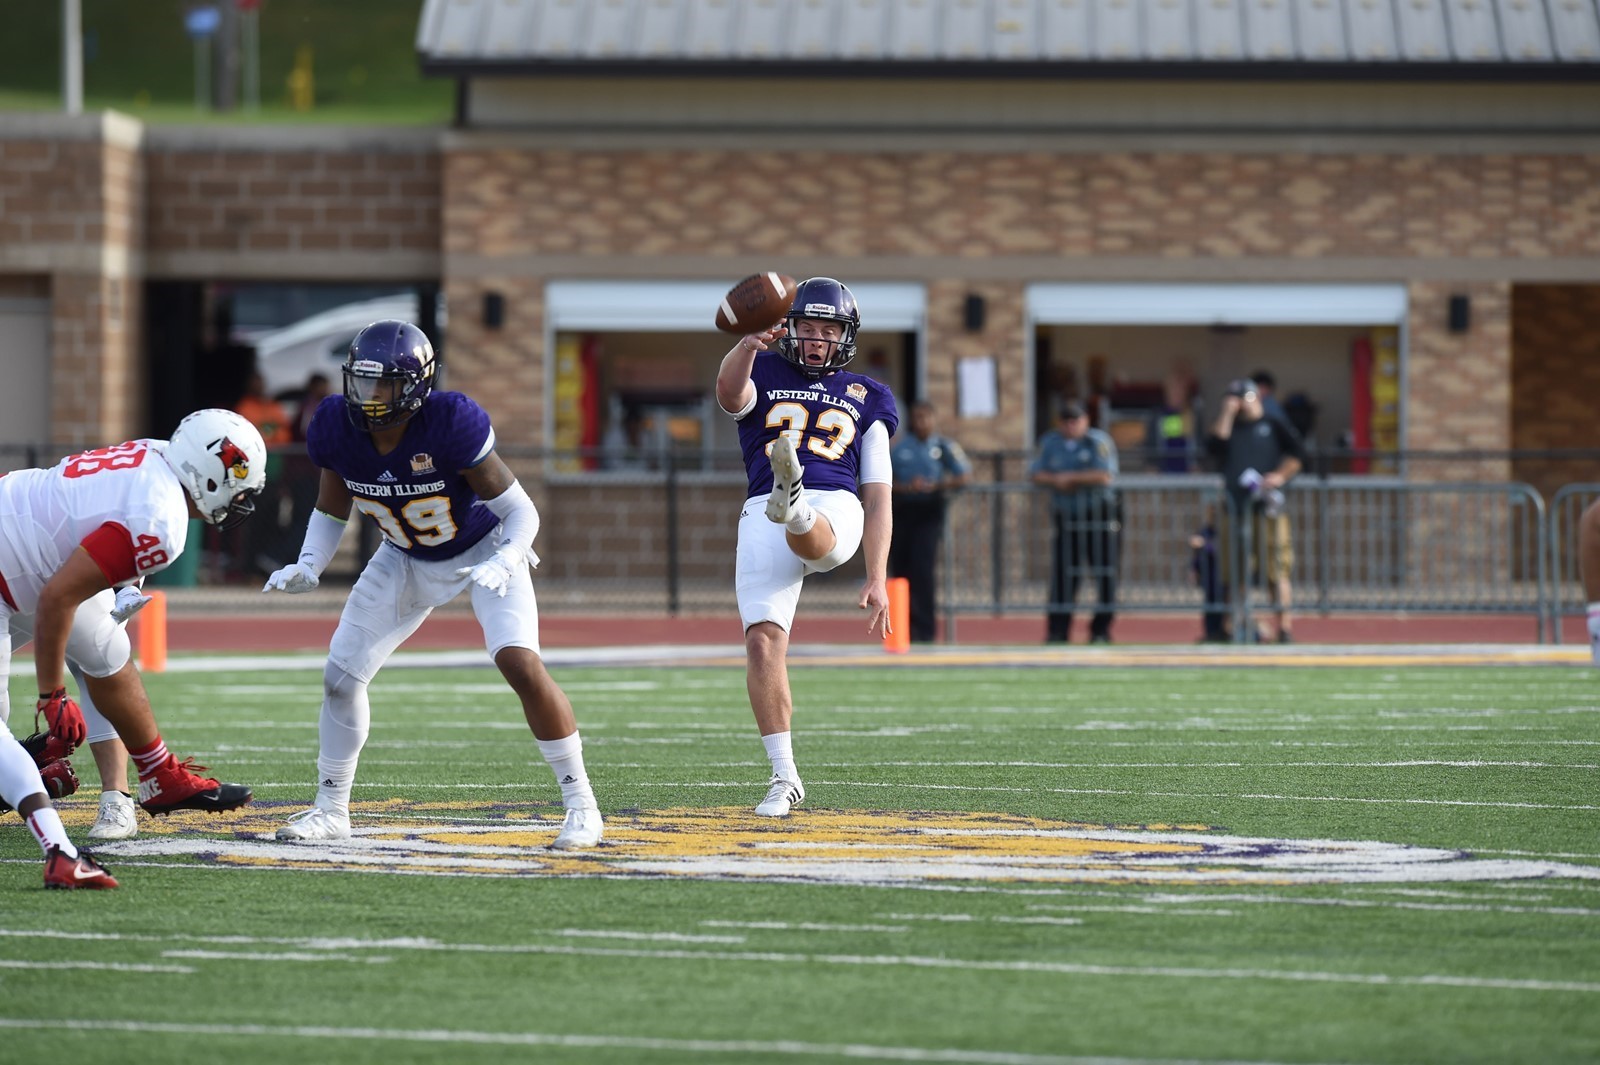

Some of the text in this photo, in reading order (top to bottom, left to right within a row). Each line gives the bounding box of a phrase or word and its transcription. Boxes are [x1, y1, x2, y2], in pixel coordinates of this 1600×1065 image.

[766, 390, 819, 401] WESTERN
[822, 394, 861, 422] ILLINOIS
[765, 401, 856, 460] 33
[343, 477, 446, 496] WESTERN ILLINOIS
[352, 495, 458, 549] 39
[134, 533, 169, 571] 48
